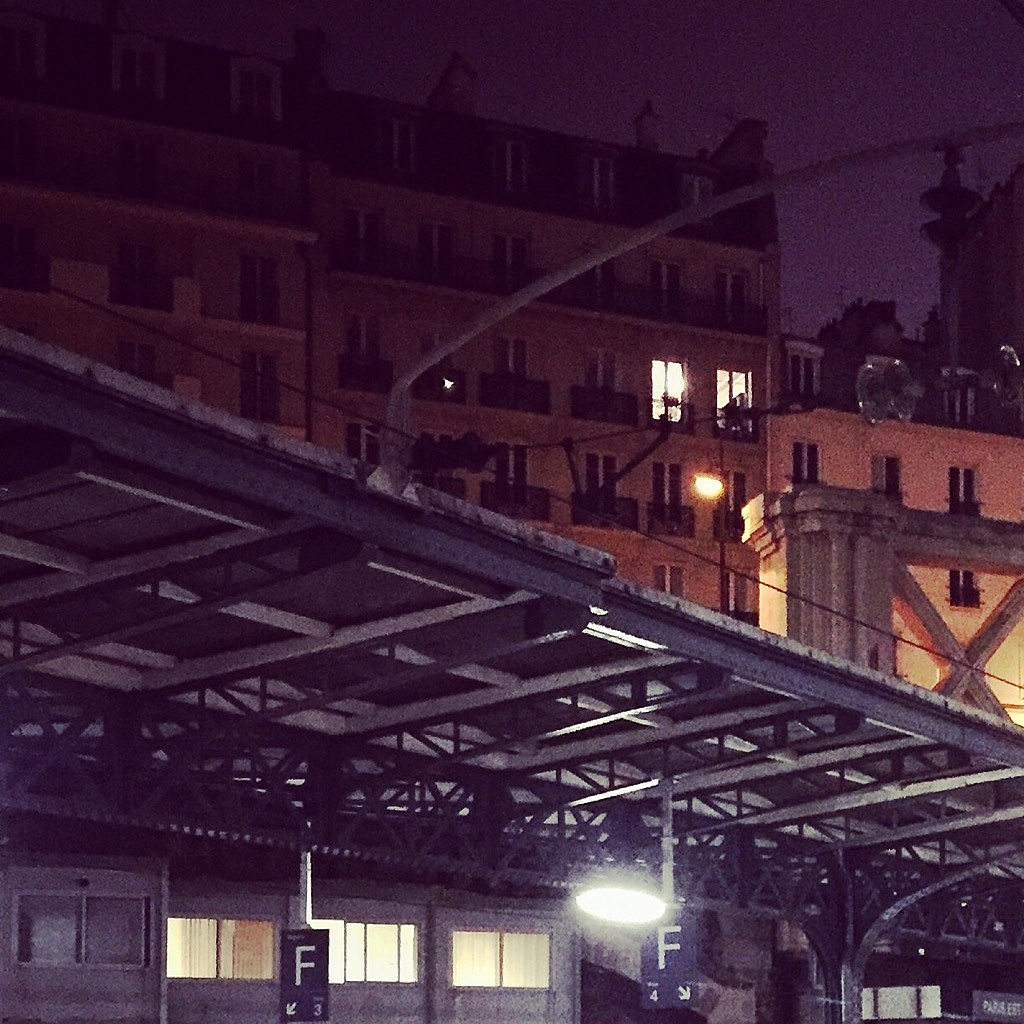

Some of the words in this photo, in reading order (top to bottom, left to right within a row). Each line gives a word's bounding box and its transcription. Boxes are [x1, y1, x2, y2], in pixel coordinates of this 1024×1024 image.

[658, 925, 681, 969] F
[295, 945, 315, 986] F
[650, 990, 658, 1002] 4
[314, 1004, 322, 1016] 3
